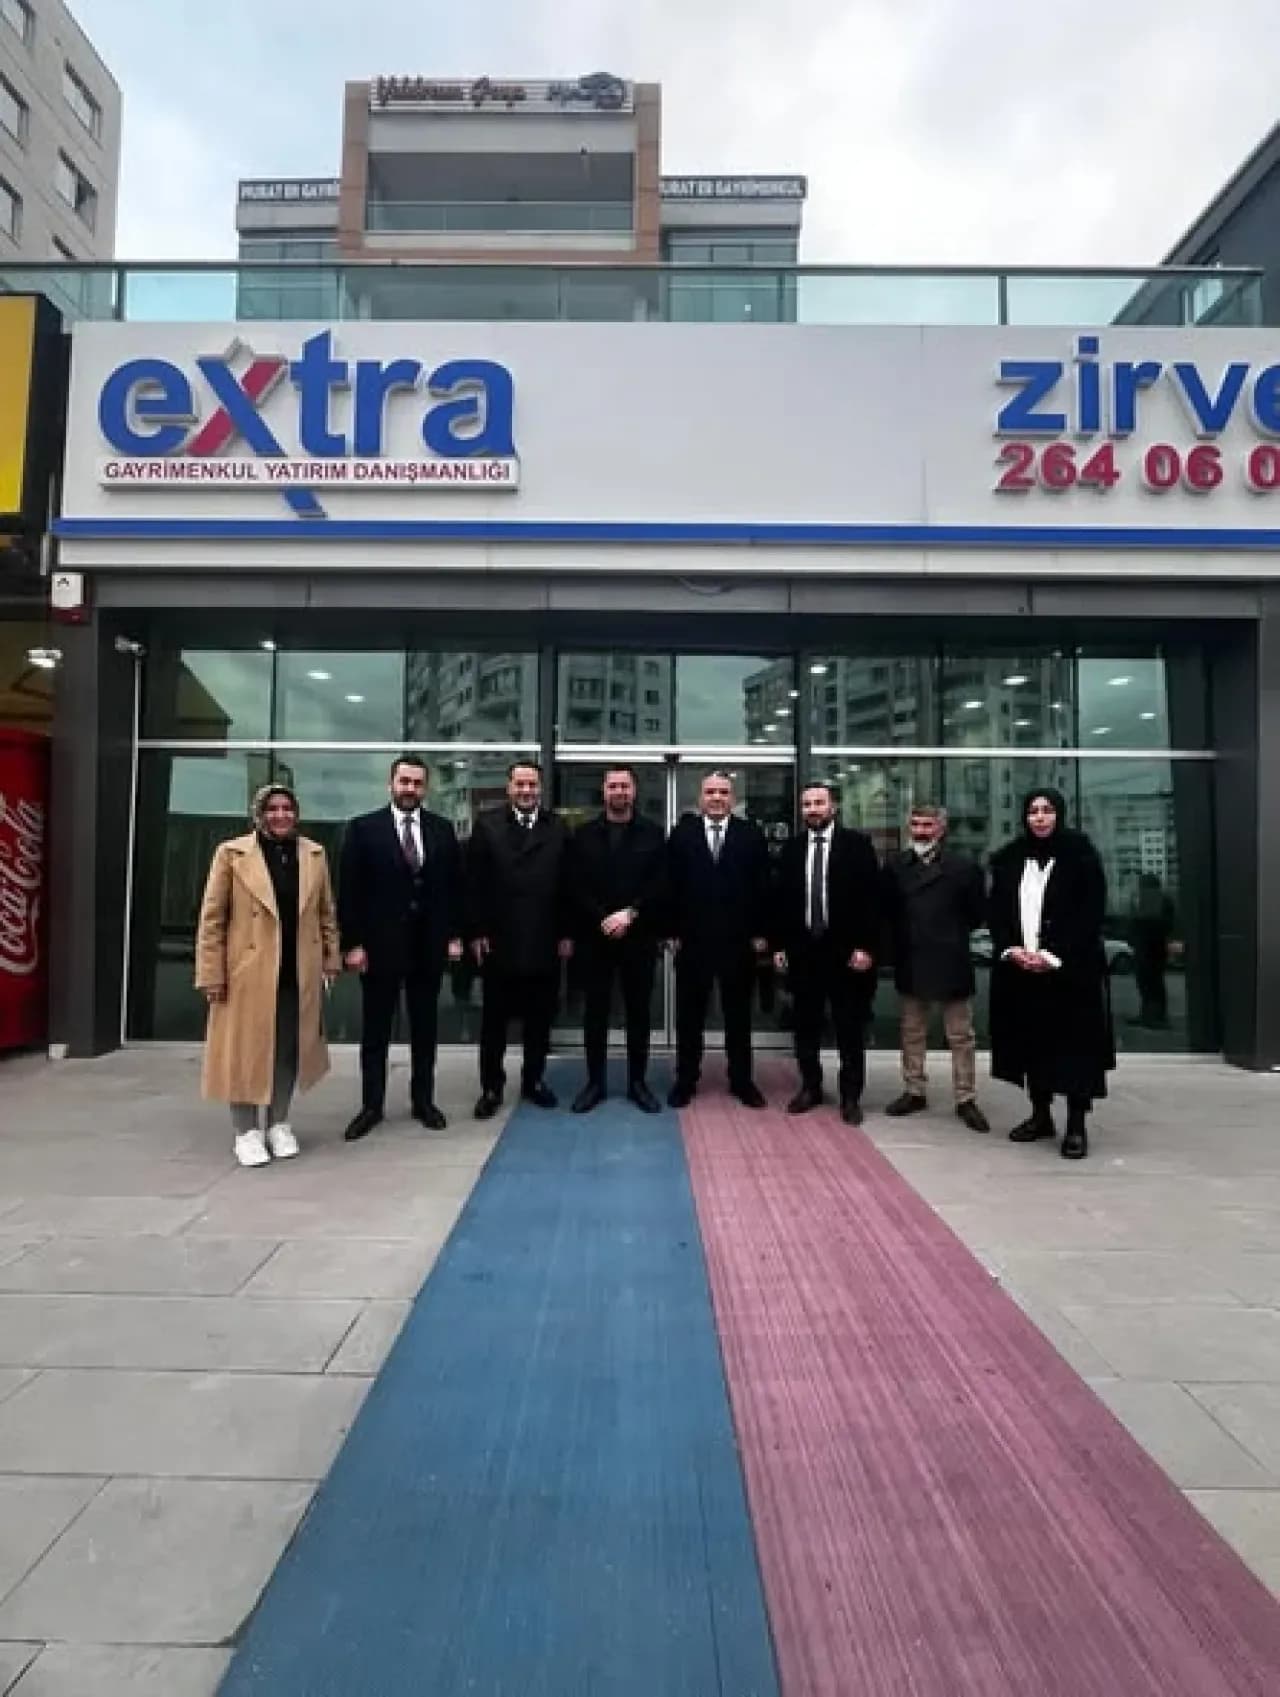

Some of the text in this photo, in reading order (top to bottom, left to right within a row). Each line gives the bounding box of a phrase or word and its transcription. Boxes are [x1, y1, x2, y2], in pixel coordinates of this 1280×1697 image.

[98, 328, 516, 458] extra
[105, 459, 511, 484] GAYRİMENKUL YATIRIM DANIŞMANLIĞI
[998, 442, 1121, 491] 264
[1143, 443, 1224, 491] 06
